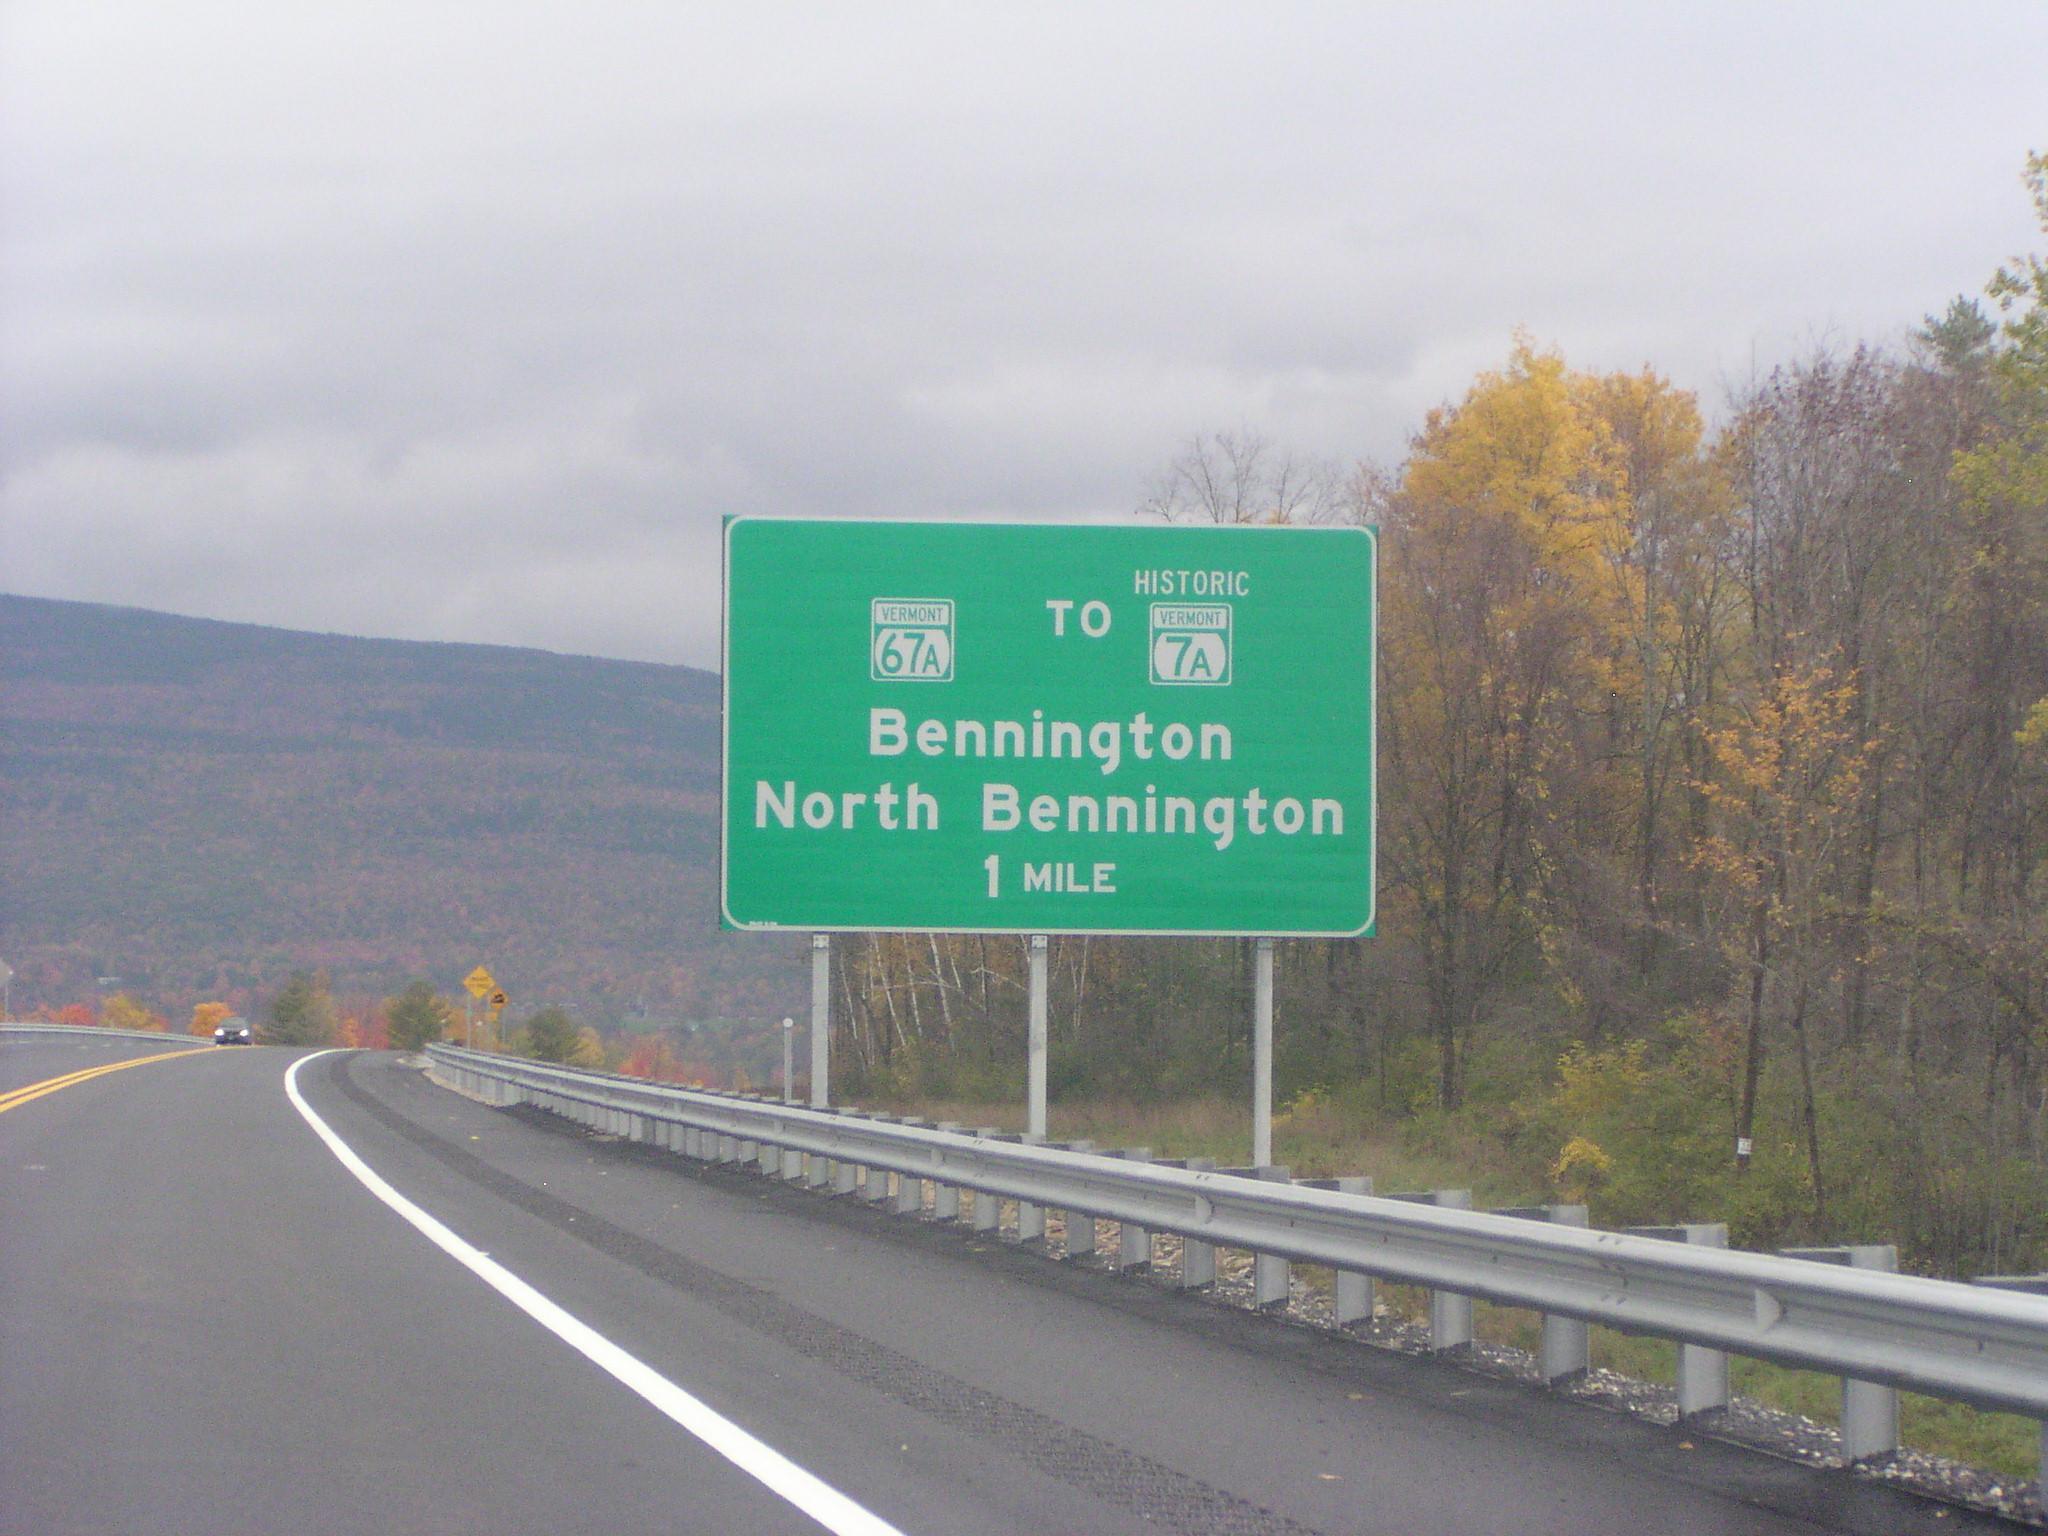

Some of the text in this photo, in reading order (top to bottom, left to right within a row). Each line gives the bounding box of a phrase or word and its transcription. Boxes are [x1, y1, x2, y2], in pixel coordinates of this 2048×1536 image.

[1134, 570, 1249, 597] HISTORIC
[881, 606, 944, 623] VERMONT
[1046, 600, 1112, 637] TO
[1159, 610, 1222, 627] VERMONT
[880, 633, 941, 676] 67A
[1165, 636, 1212, 677] 7A
[870, 708, 1232, 775] Bennington
[756, 781, 1343, 851] North Bennington
[984, 854, 1117, 898] 1 MILE
